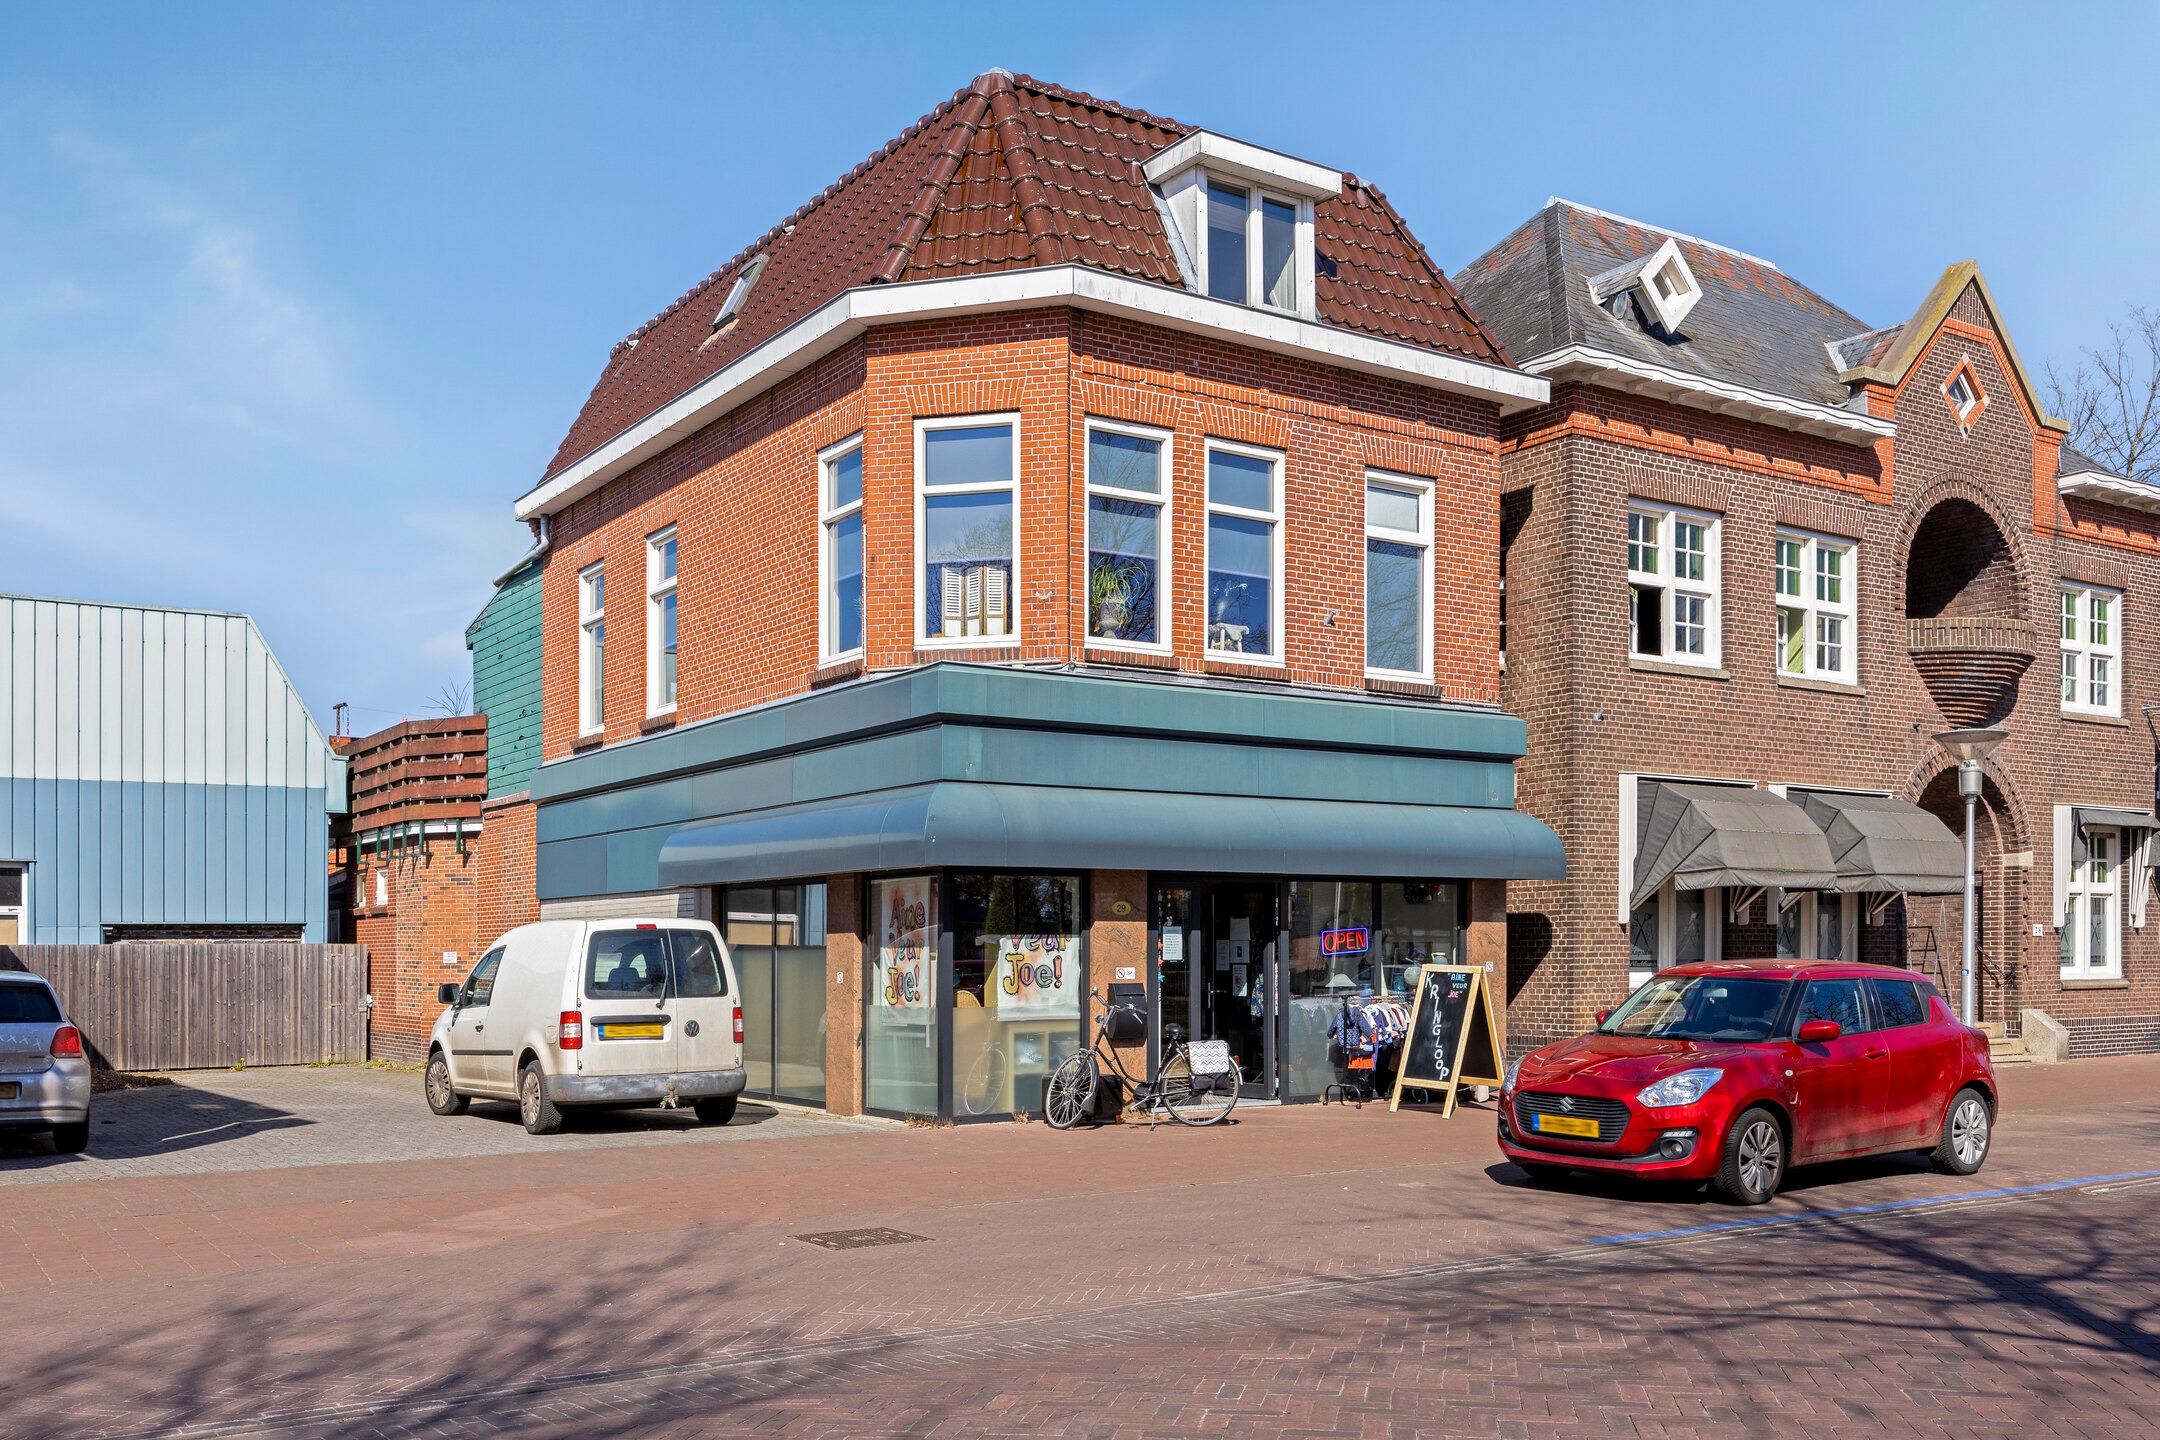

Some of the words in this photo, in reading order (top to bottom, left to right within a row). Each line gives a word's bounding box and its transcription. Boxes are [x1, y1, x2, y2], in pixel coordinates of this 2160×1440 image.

[1117, 904, 1126, 912] 29
[1324, 930, 1366, 952] OPEN
[885, 964, 921, 1006] Joe!
[1003, 953, 1063, 995] Joe!
[1425, 972, 1450, 1081] KRINGLOOP
